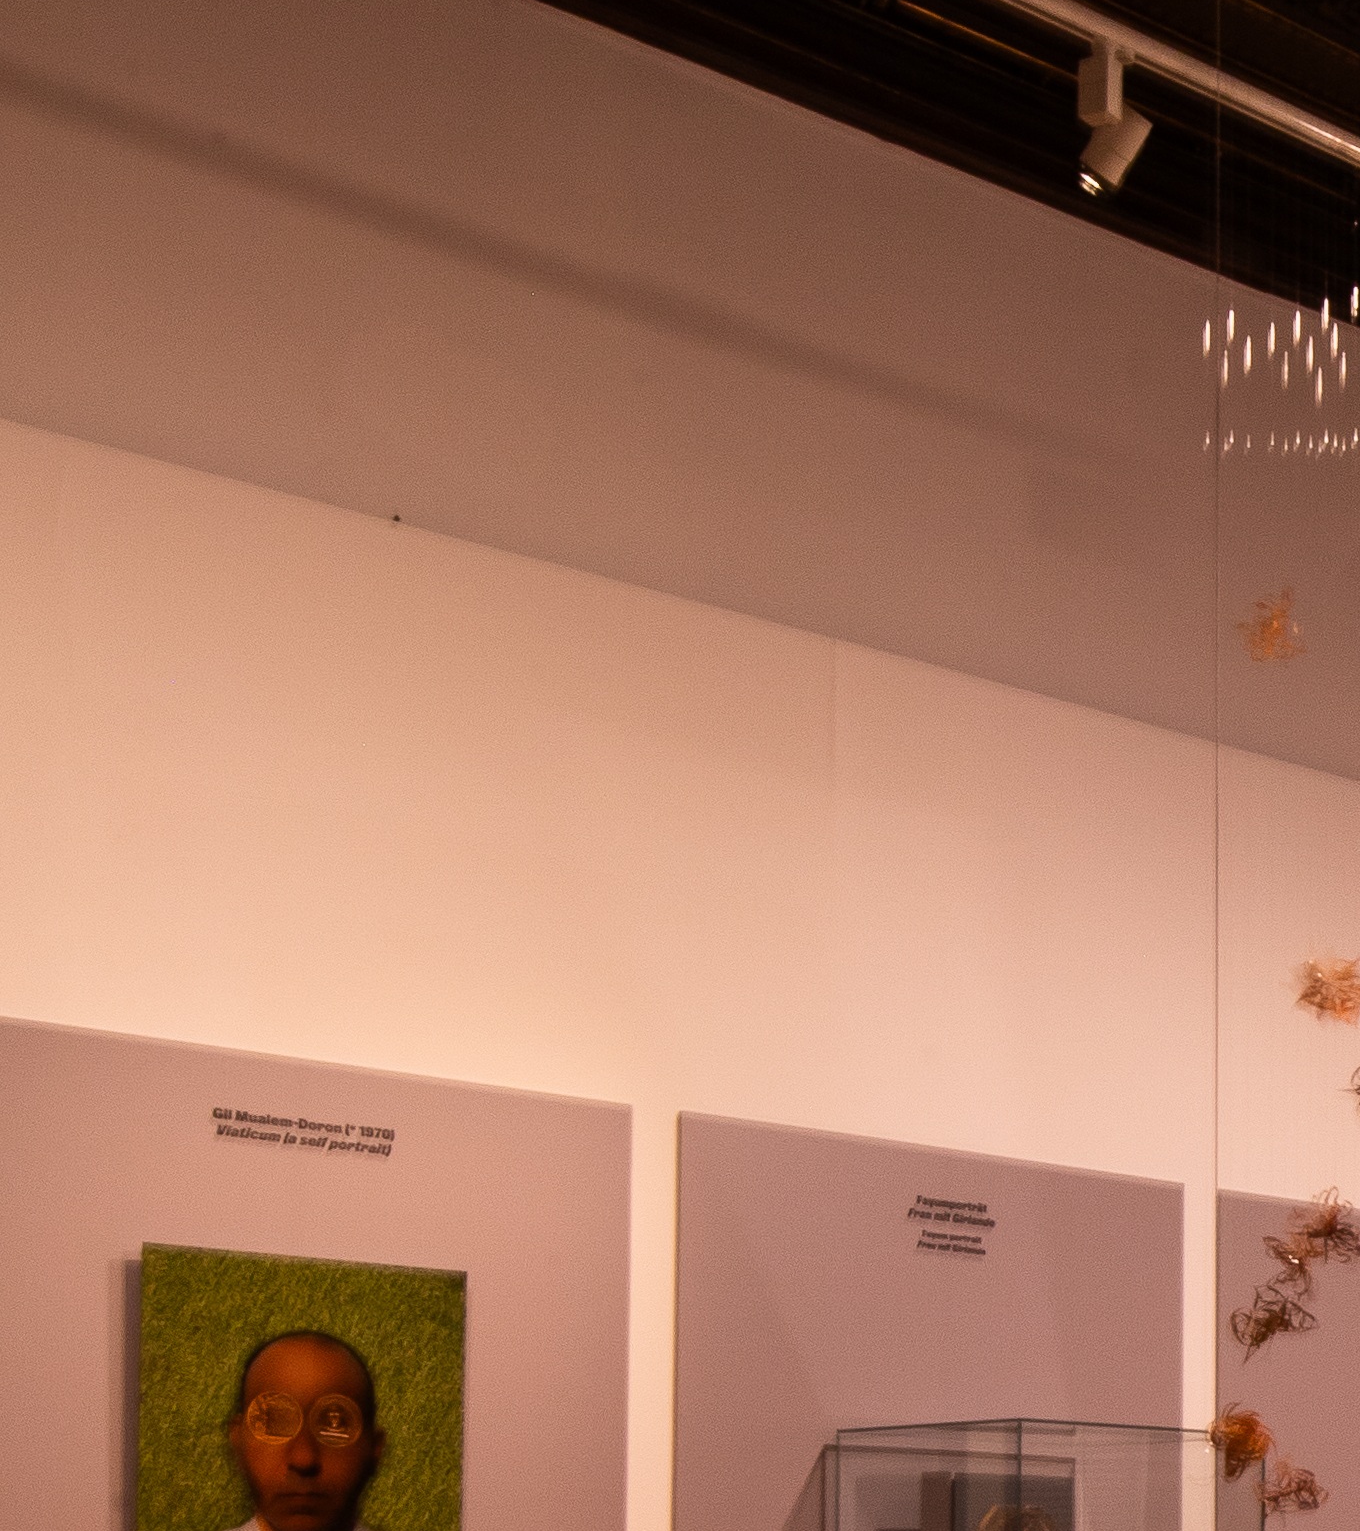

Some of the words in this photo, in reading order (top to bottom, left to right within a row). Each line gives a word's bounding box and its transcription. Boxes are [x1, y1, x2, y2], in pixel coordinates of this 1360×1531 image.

[212, 1107, 232, 1120] Gil
[235, 1111, 342, 1134] Mualem-Doron
[216, 1124, 281, 1142] Viaticum
[300, 1137, 328, 1147] self
[328, 1139, 392, 1157] portrait)
